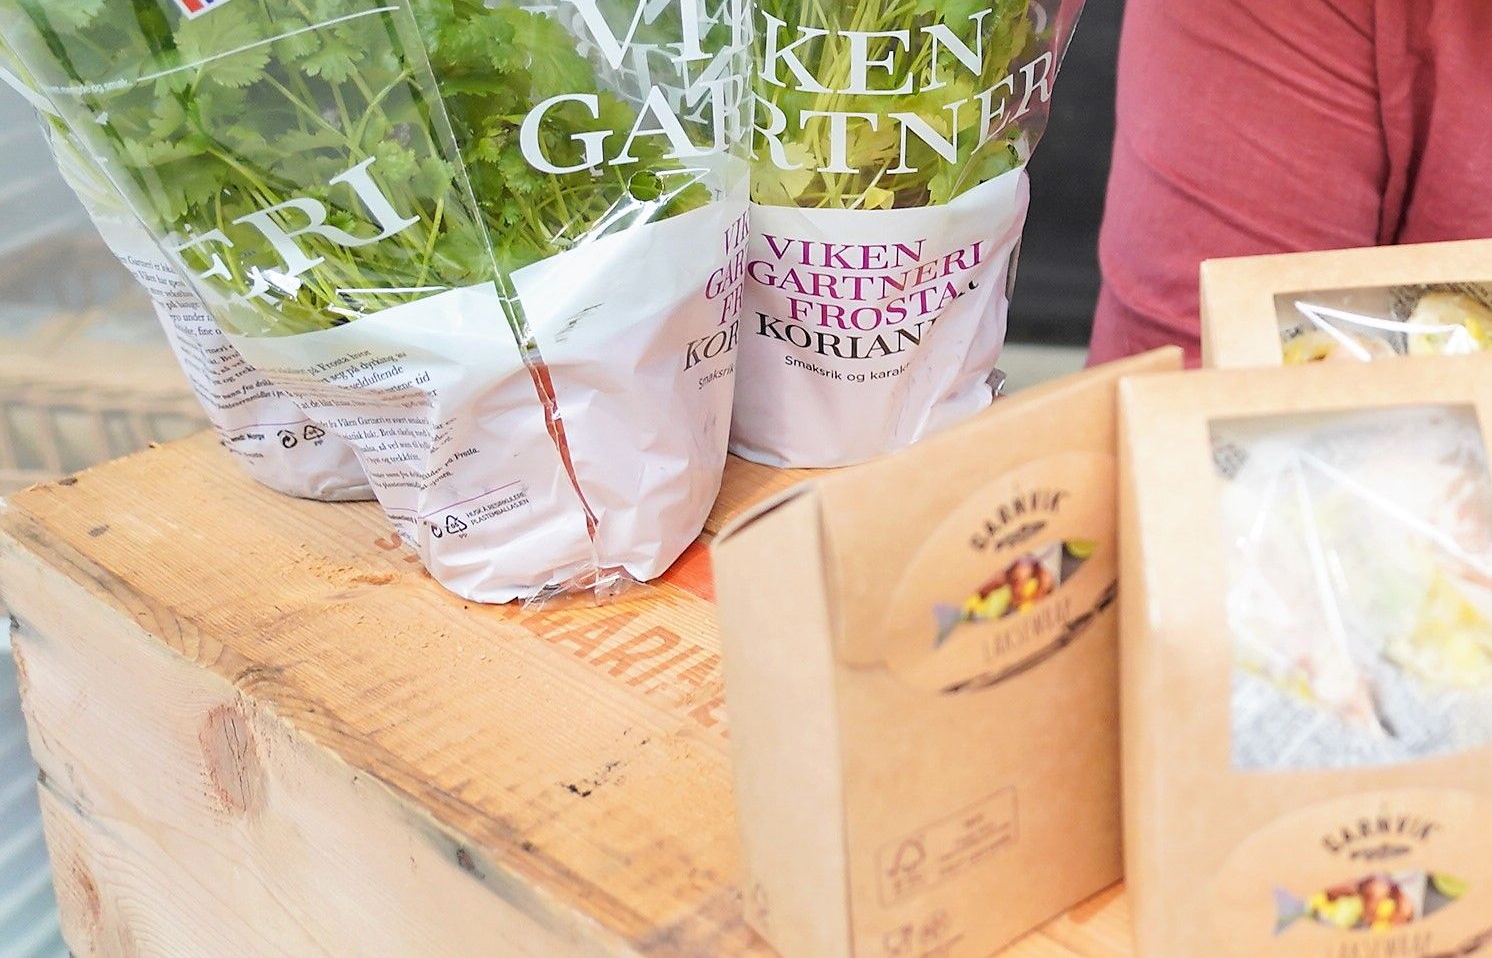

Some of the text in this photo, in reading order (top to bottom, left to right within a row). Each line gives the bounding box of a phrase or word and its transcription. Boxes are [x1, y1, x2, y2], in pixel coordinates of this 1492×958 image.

[747, 240, 984, 302] GARTNERI
[761, 232, 927, 271] VIKEN
[786, 282, 959, 331] FROSTA
[415, 370, 431, 384] tid
[785, 354, 842, 382] Smaksrik
[846, 370, 866, 384] og
